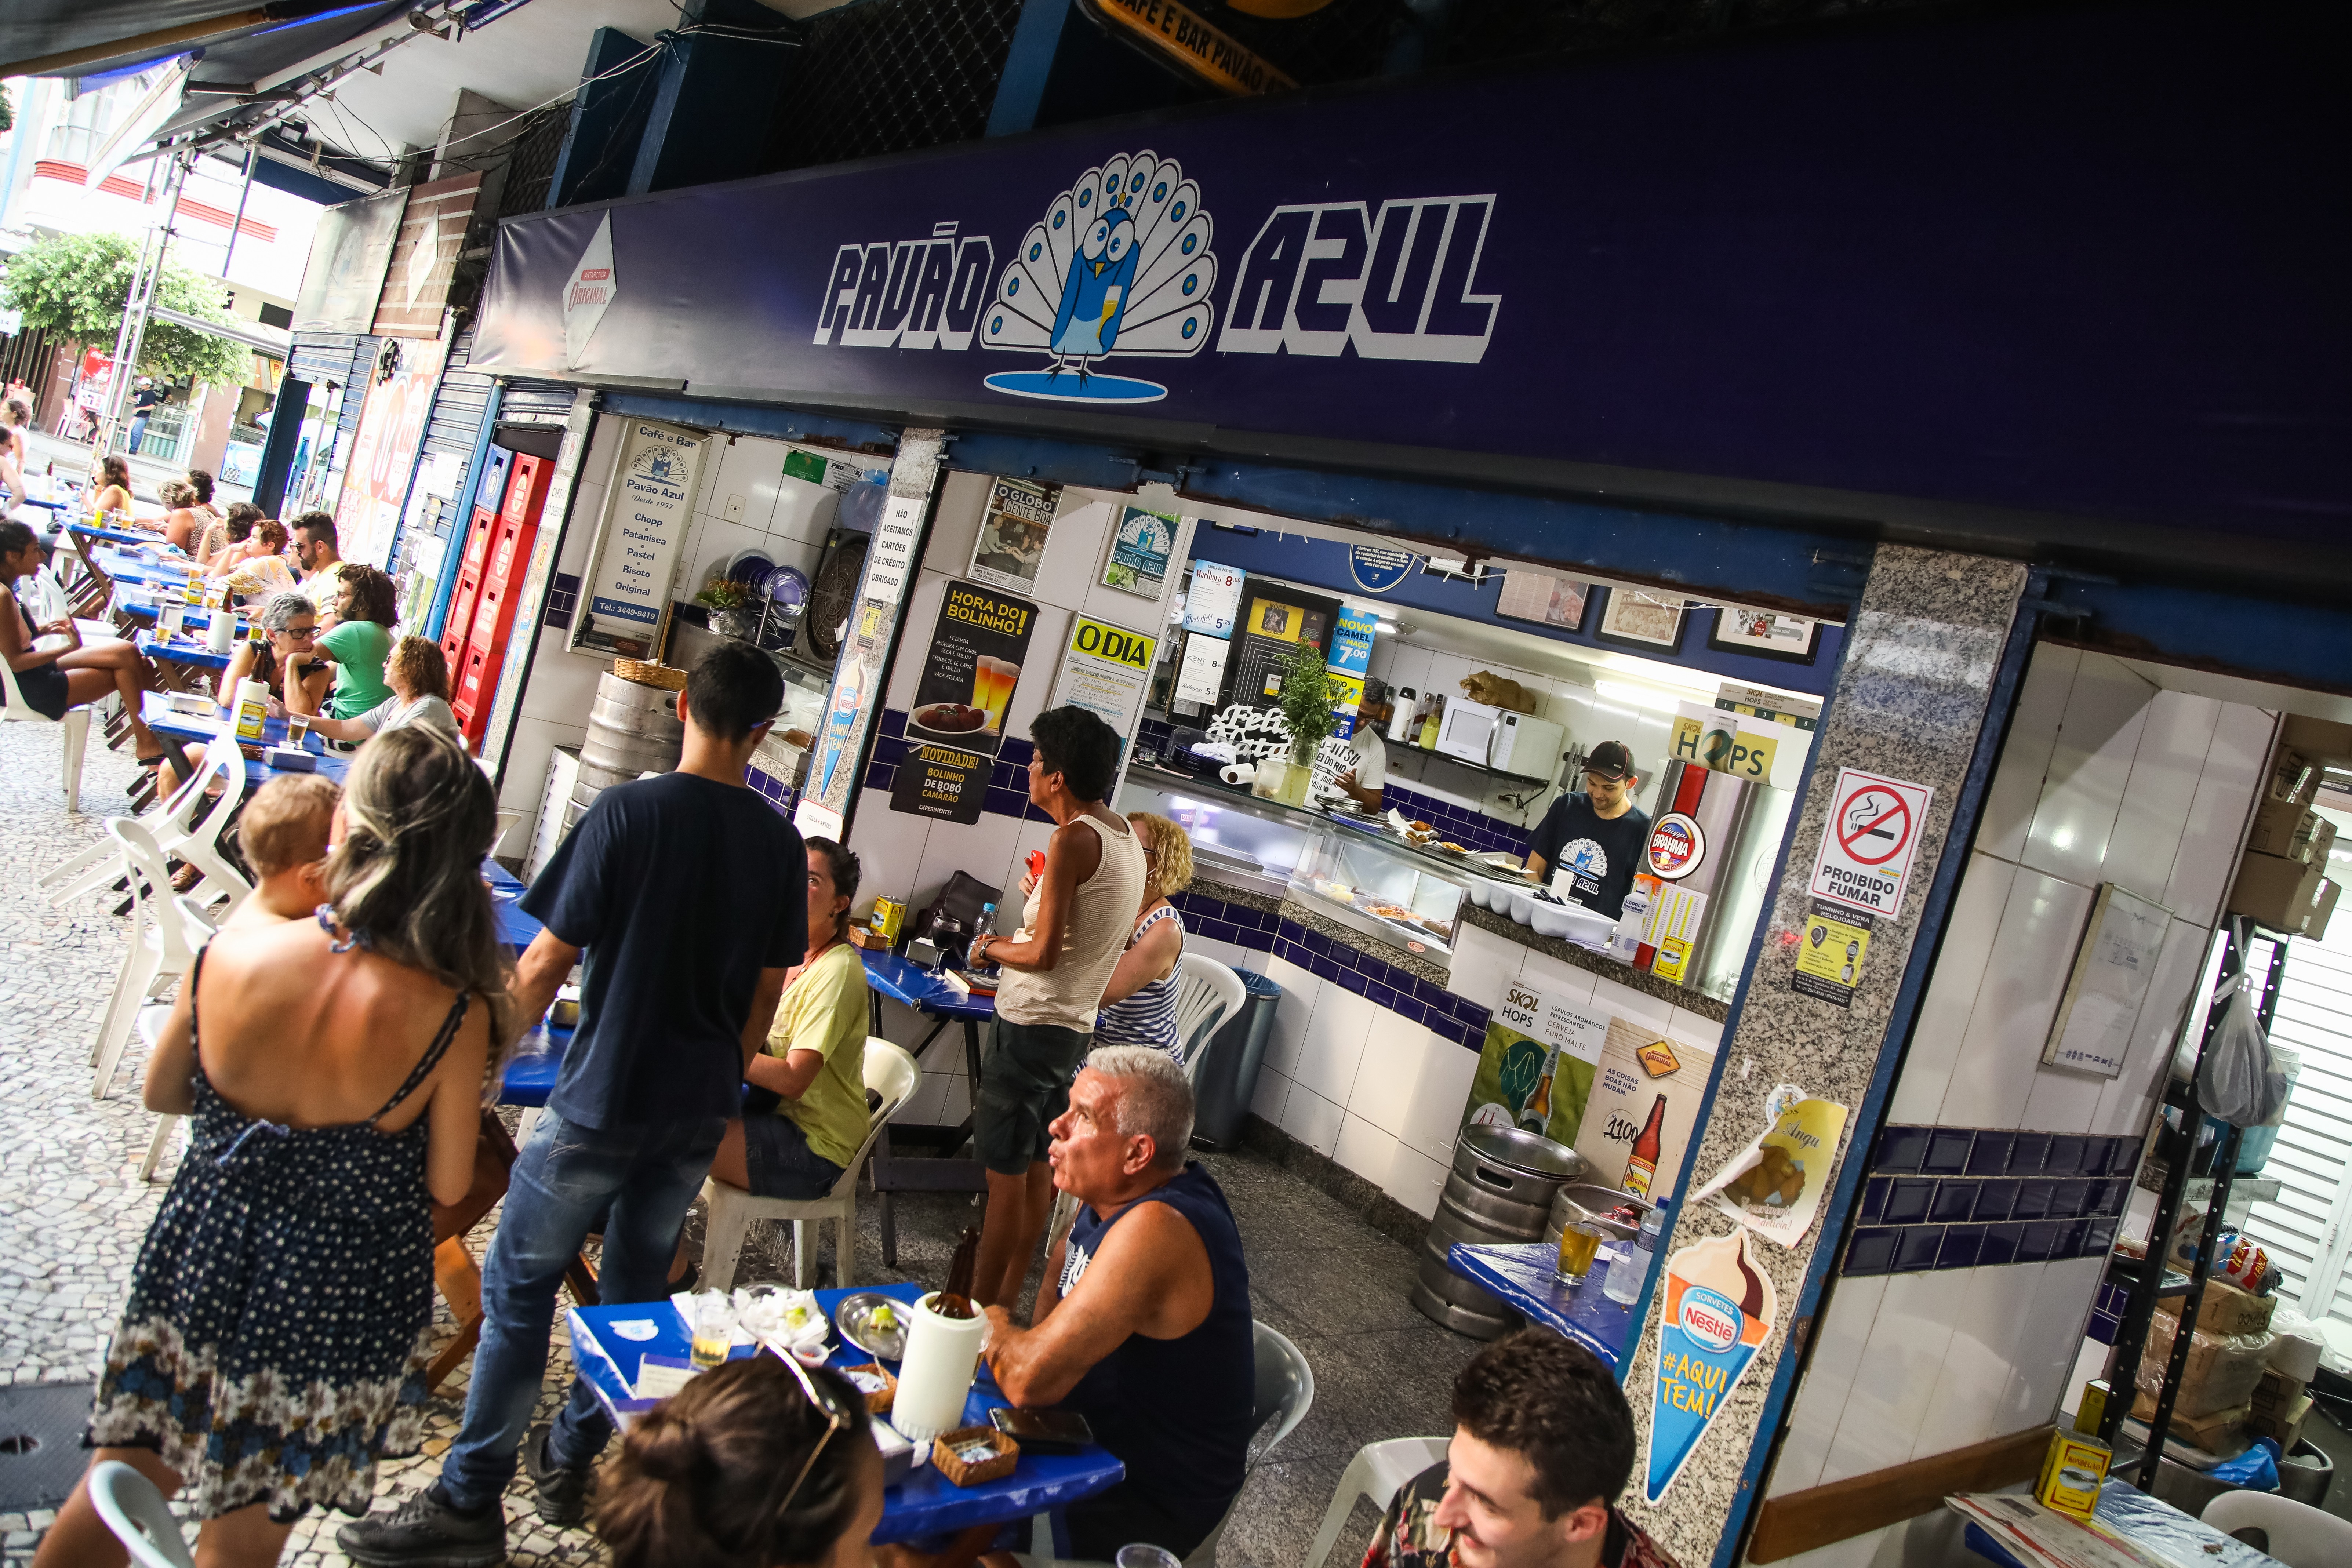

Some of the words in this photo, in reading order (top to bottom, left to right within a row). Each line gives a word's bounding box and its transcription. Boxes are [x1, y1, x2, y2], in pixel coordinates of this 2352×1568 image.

[1161, 6, 1176, 34] E
[1175, 15, 1211, 58] BAR
[1211, 41, 1263, 92] PAVÃO
[813, 222, 993, 350] PAVÃO
[1217, 194, 1502, 363] AZUL
[568, 281, 607, 312] ORIGINAL
[640, 426, 664, 440] Café
[676, 436, 696, 448] Bar
[552, 487, 567, 499] CARTÃO
[627, 479, 658, 495] Pavão
[661, 487, 684, 501] Azul
[632, 494, 654, 505] Desde
[656, 499, 674, 509] 1957
[999, 486, 1008, 496] O
[1011, 490, 1051, 511] GLOBO
[545, 502, 551, 514] SÓ
[550, 504, 564, 518] DÉBITO
[896, 508, 907, 519] NÃO
[1006, 500, 1032, 519] GENTE
[1034, 509, 1050, 525] BOA
[635, 513, 662, 527] Chopp
[623, 528, 666, 546] Patanisca
[883, 524, 913, 536] ACEITAMOS
[627, 547, 655, 561] Pastel
[881, 541, 906, 552] CARTÕES
[874, 556, 881, 564] DE
[882, 557, 905, 569] CRÉDITO
[1113, 550, 1141, 569] PAVÃO
[1142, 560, 1163, 576] AZUL
[623, 565, 651, 578] Risoto
[872, 573, 898, 586] OBRIGADO
[1196, 569, 1222, 582] Marlboro
[1225, 576, 1240, 586] 8,00
[615, 582, 651, 596] Original
[600, 603, 615, 612] Tel.:
[617, 606, 655, 620] 3449-9419
[951, 590, 993, 613] HORA
[998, 604, 1019, 619] DO
[1186, 614, 1213, 624] Chesterfield
[1216, 618, 1230, 629] 5,25
[1339, 618, 1373, 634] NOVO
[949, 635, 969, 644] FEIJOADA
[1337, 628, 1370, 642] CAMEL
[935, 640, 955, 649] ABÓBORA
[965, 647, 977, 655] CARNE
[1077, 625, 1101, 651] O
[1101, 631, 1145, 667] DIA
[1346, 639, 1369, 649] MAÇO
[1187, 655, 1206, 663] KENT
[1339, 645, 1367, 663] 7,00
[932, 655, 953, 665] CROQUETE
[960, 662, 973, 670] CARNE
[934, 671, 945, 679] VACA
[945, 674, 963, 683] ATOLADA
[1181, 683, 1203, 691] Rothmans
[1747, 688, 1763, 697] SKOL
[1745, 696, 1761, 705] HOPS
[831, 722, 850, 738] #AQUI
[1683, 723, 1701, 733] SKOL
[829, 736, 845, 751] TEM!
[1205, 726, 1291, 758] Nata
[920, 746, 979, 770] NOVIDADE!
[1324, 756, 1333, 767] DO
[1333, 761, 1346, 774] RIO
[927, 768, 964, 782] BOLINHO
[924, 779, 937, 788] DE
[937, 781, 961, 793] BOBÓ
[922, 789, 958, 803] CAMARÃO
[919, 804, 952, 815] EXPERIMENTE!
[807, 814, 818, 823] STELLA
[820, 819, 832, 829] ARTOIS
[1661, 826, 1687, 838] Chopp
[1652, 834, 1688, 856] BRAHMA
[1576, 878, 1599, 895] AZUL
[1822, 865, 1894, 895] PROIBIDO
[1828, 882, 1881, 906] FUMAR
[1624, 903, 1644, 913] Montebelo
[1817, 903, 1844, 916] TUNINHO
[1853, 914, 1869, 923] VERA
[1821, 912, 1861, 927] RELOJOARIA
[1506, 989, 1539, 1012] SKOL
[1502, 1005, 1533, 1027] HOPS
[1550, 1012, 1584, 1030] REFRESCANTES
[1552, 1005, 1573, 1017] LÚPULOS
[1574, 1015, 1605, 1031] AROMÁTICOS
[1548, 1020, 1575, 1036] CERVEJA
[1545, 1028, 1563, 1040] PURO
[1565, 1037, 1586, 1051] MALTE
[1646, 1052, 1671, 1067] ORIGINAL
[1605, 1075, 1622, 1085] BOAS
[1622, 1082, 1636, 1092] NÃO
[1617, 1072, 1639, 1085] COISAS
[1603, 1082, 1626, 1096] MUDAM.
[1782, 1120, 1820, 1149] Angu
[1632, 1158, 1651, 1169] ANTARCTICA
[1625, 1173, 1648, 1189] ORIGINAL
[1695, 1292, 1734, 1316] SORVETES
[1685, 1307, 1734, 1340] Nestlé
[1662, 1352, 1727, 1394] #AQUI
[1660, 1376, 1716, 1420] TEM!
